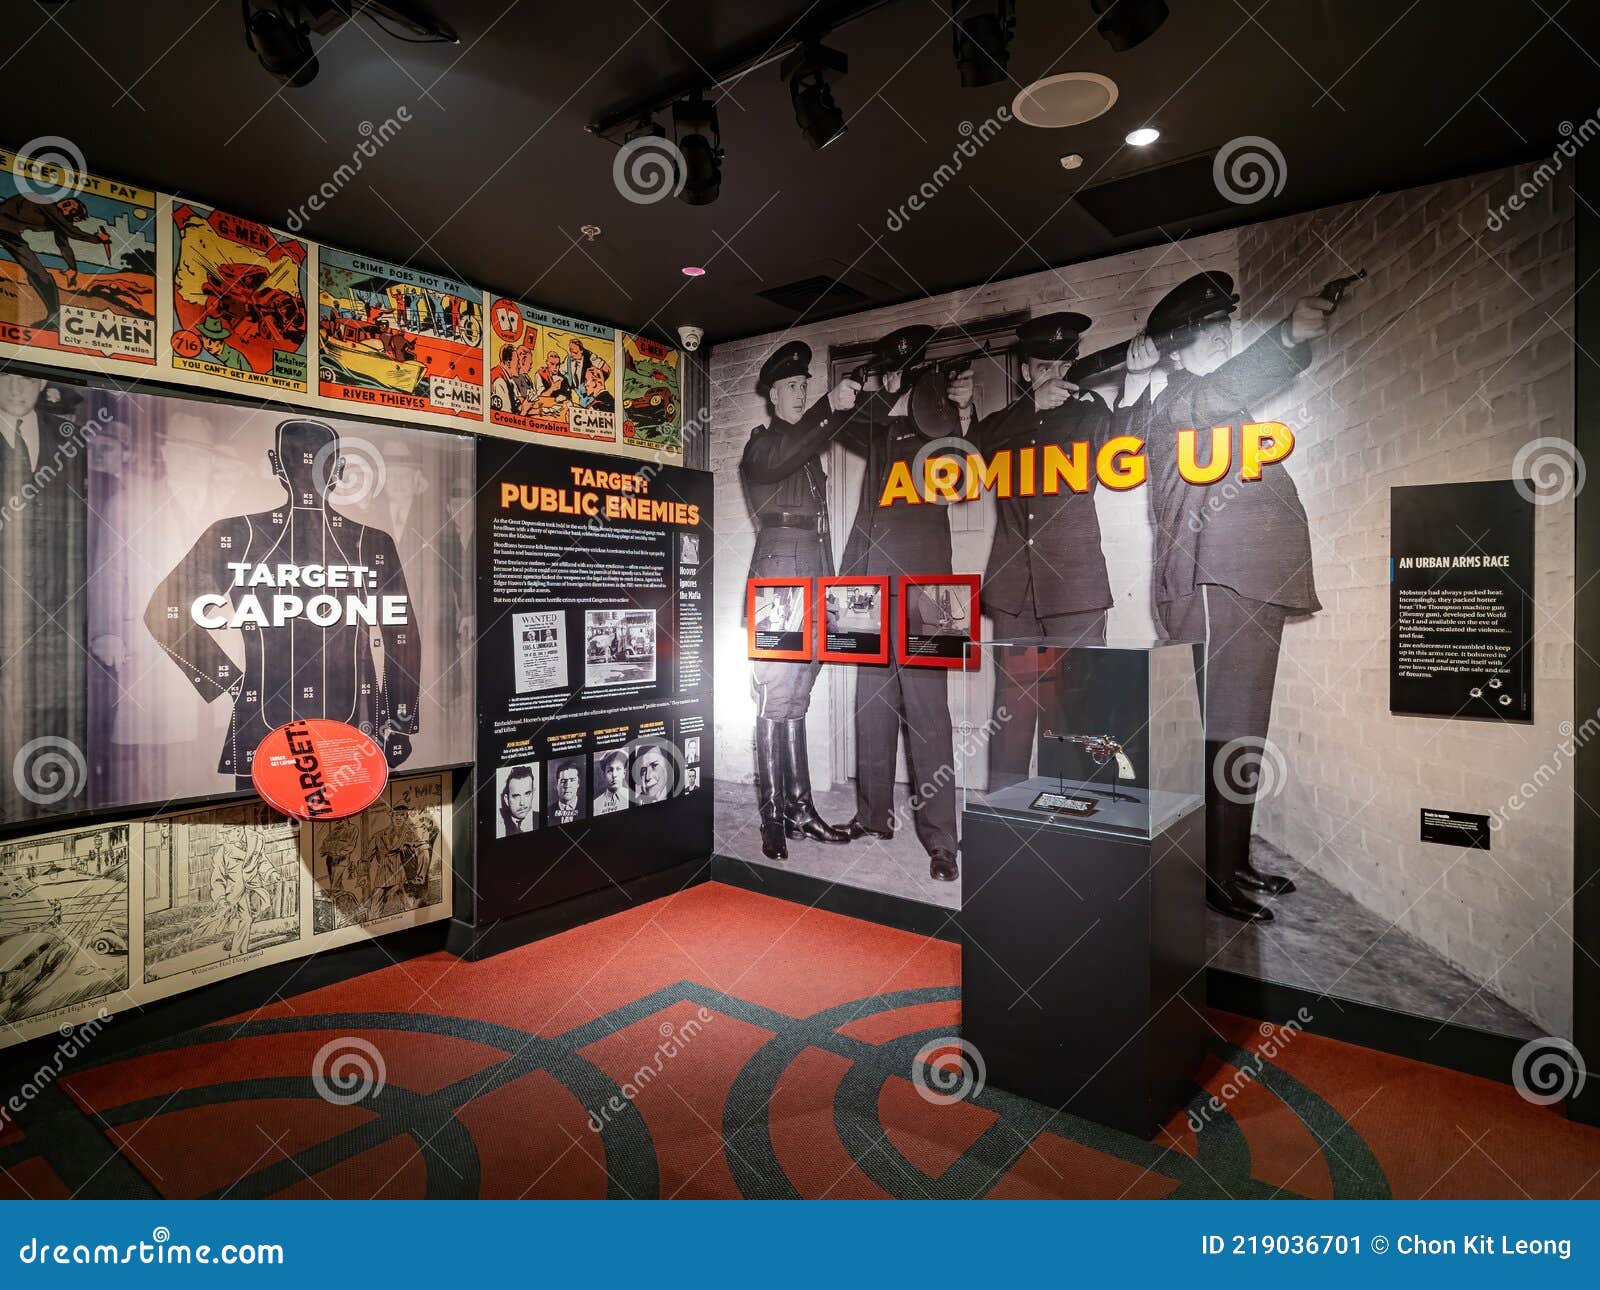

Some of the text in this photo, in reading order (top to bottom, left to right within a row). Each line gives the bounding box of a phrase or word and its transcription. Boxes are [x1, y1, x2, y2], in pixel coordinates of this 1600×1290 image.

[17, 160, 58, 179] DOES
[69, 173, 101, 190] NOT
[110, 183, 137, 199] PAY
[218, 220, 269, 248] G-MEN
[352, 259, 459, 292] CRIME DOES NOT PAY
[65, 308, 151, 327] AMERICAN
[526, 310, 607, 336] CRIME DOES NOT PAY
[65, 317, 152, 346] G-MEN
[182, 360, 200, 369] YOU
[204, 364, 228, 375] CAN'T
[230, 371, 246, 379] GET
[248, 374, 269, 383] AWAY
[272, 378, 290, 388] WITH
[343, 388, 376, 401] RIVER
[380, 393, 425, 408] THIEVES
[434, 386, 481, 405] G-MEN
[494, 413, 527, 427] Crooked
[529, 420, 567, 434] Gamblers
[573, 414, 613, 430] G-MEN
[880, 420, 1296, 508] ARMING UP
[571, 466, 648, 493] TARGET:
[501, 482, 701, 525] PUBLIC ENEMIES
[1399, 555, 1510, 568] AN URBAN ARMS RACE
[228, 562, 378, 588] TARGET:
[190, 593, 409, 629] CAPONE
[522, 614, 557, 623] WANTED
